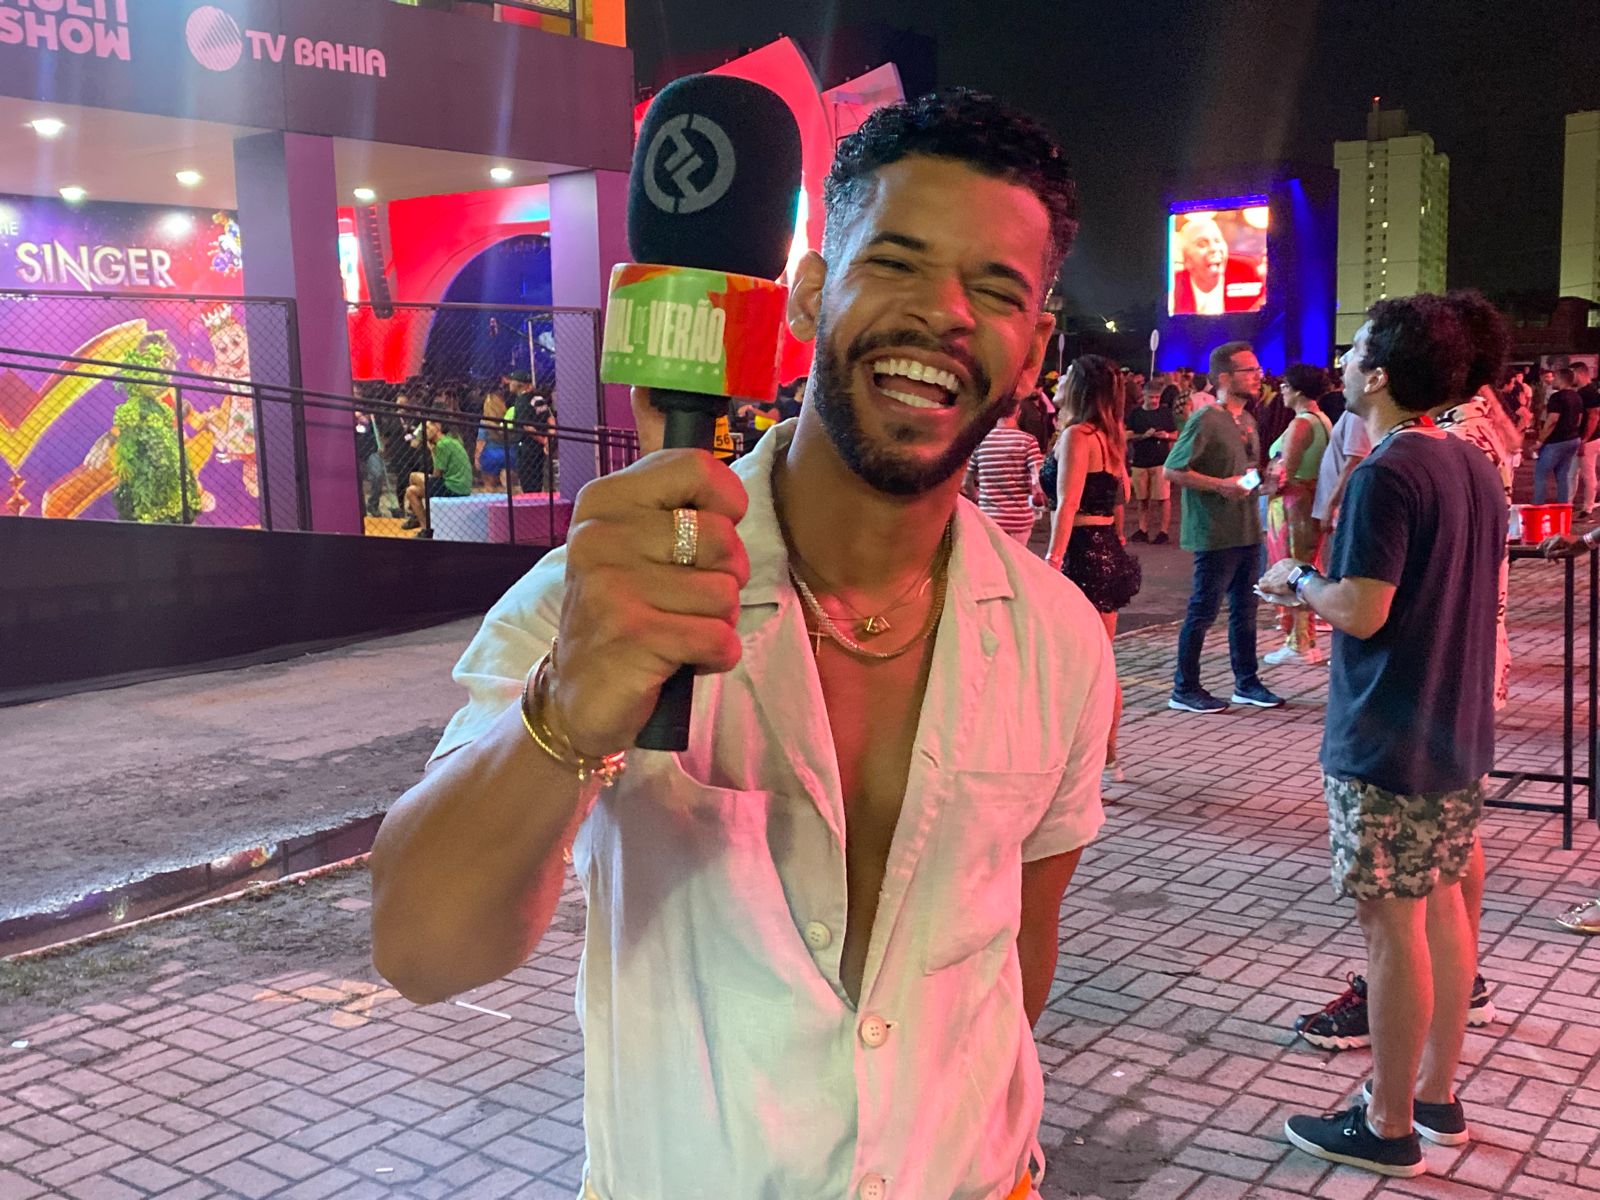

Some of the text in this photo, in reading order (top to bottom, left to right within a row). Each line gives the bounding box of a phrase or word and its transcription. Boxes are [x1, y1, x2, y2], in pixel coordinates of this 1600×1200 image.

[0, 6, 131, 61] SHOW
[245, 29, 386, 77] TV BAHIA
[16, 239, 176, 292] SINGER
[647, 299, 726, 364] VERÃO
[715, 433, 730, 447] 56
